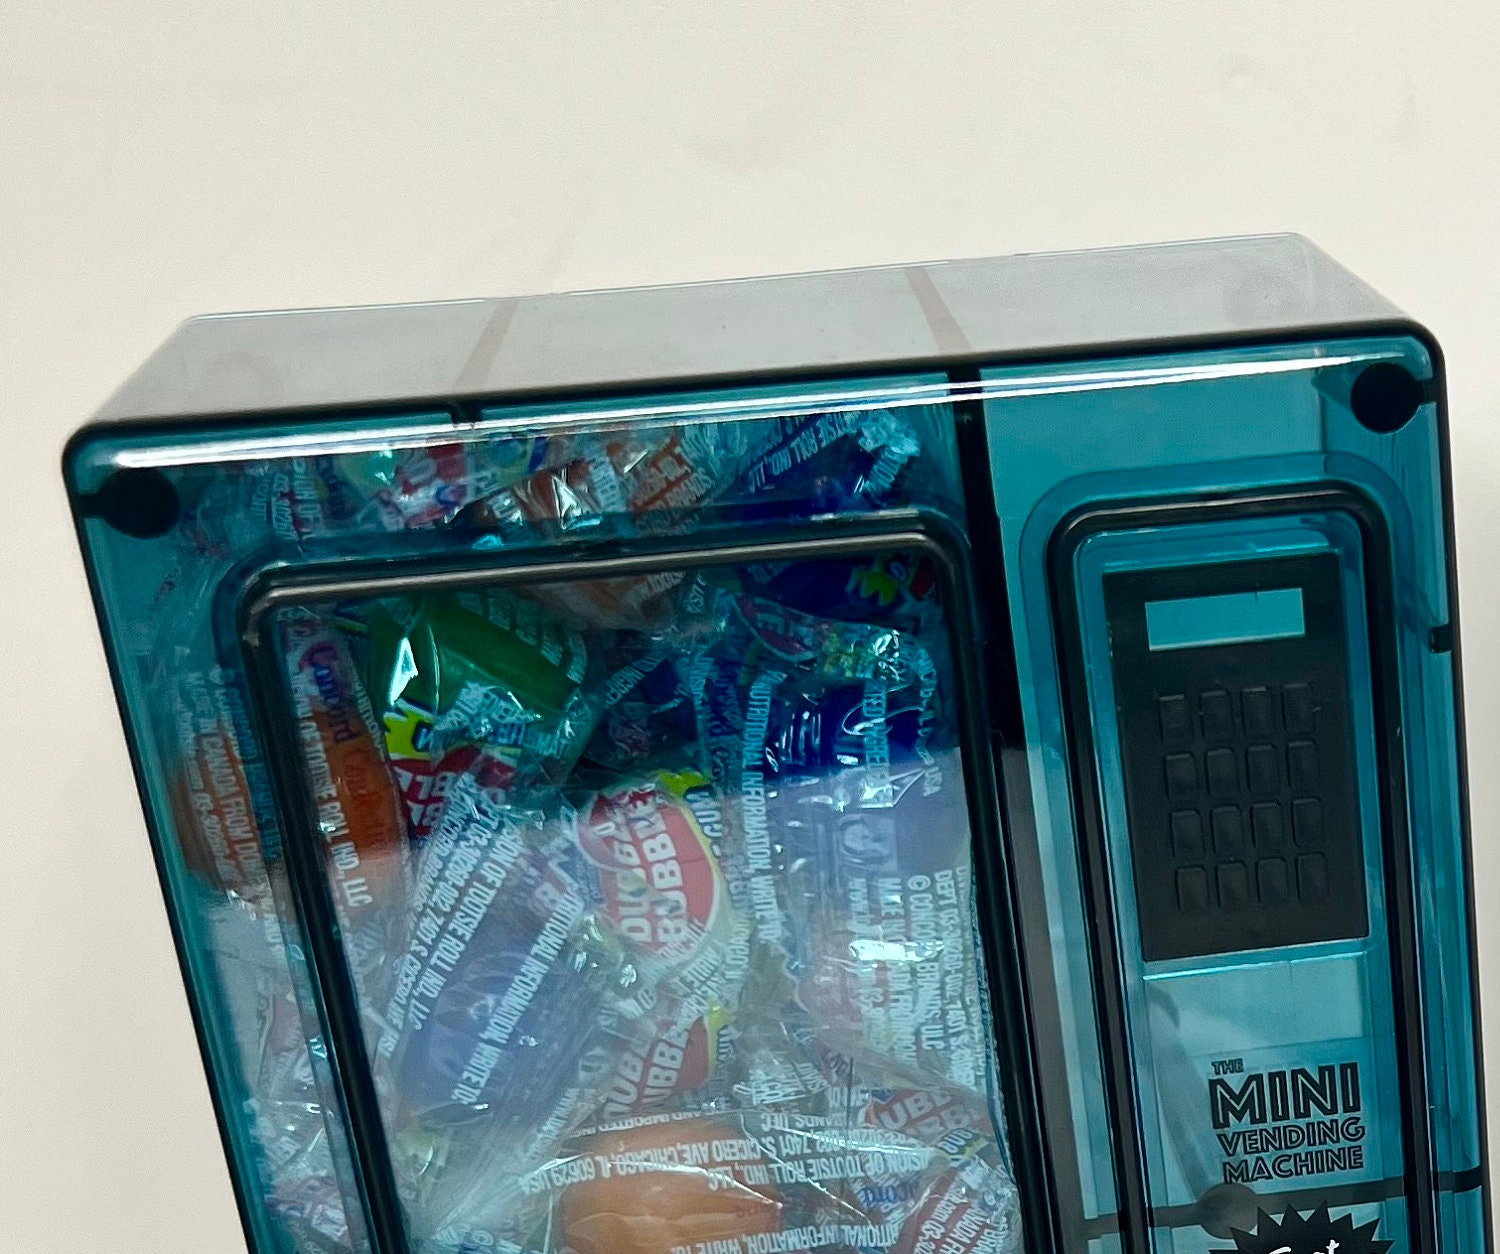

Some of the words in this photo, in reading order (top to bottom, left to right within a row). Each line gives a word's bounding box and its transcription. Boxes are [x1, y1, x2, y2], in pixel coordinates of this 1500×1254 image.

[202, 734, 239, 797] CANADA
[220, 796, 253, 840] FROM
[475, 858, 509, 891] OF
[933, 868, 957, 906] DEPT
[341, 875, 375, 910] LLC
[446, 879, 497, 943] TOOTSIE
[427, 931, 468, 975] ROLL
[398, 997, 432, 1032] LLC
[944, 1001, 967, 1034] 7401
[919, 1023, 944, 1052] ULC
[467, 1043, 501, 1086] WRITE
[1211, 1058, 1244, 1076] THE
[1208, 1062, 1362, 1130] MINI
[713, 1138, 761, 1162] CICERO
[780, 1135, 812, 1155] 7401
[1216, 1116, 1366, 1157] VENDING
[551, 1159, 597, 1187] 60629
[769, 1160, 809, 1184] ROLL
[808, 1158, 864, 1183] TOOTSIE
[1223, 1145, 1364, 1183] MACHINE
